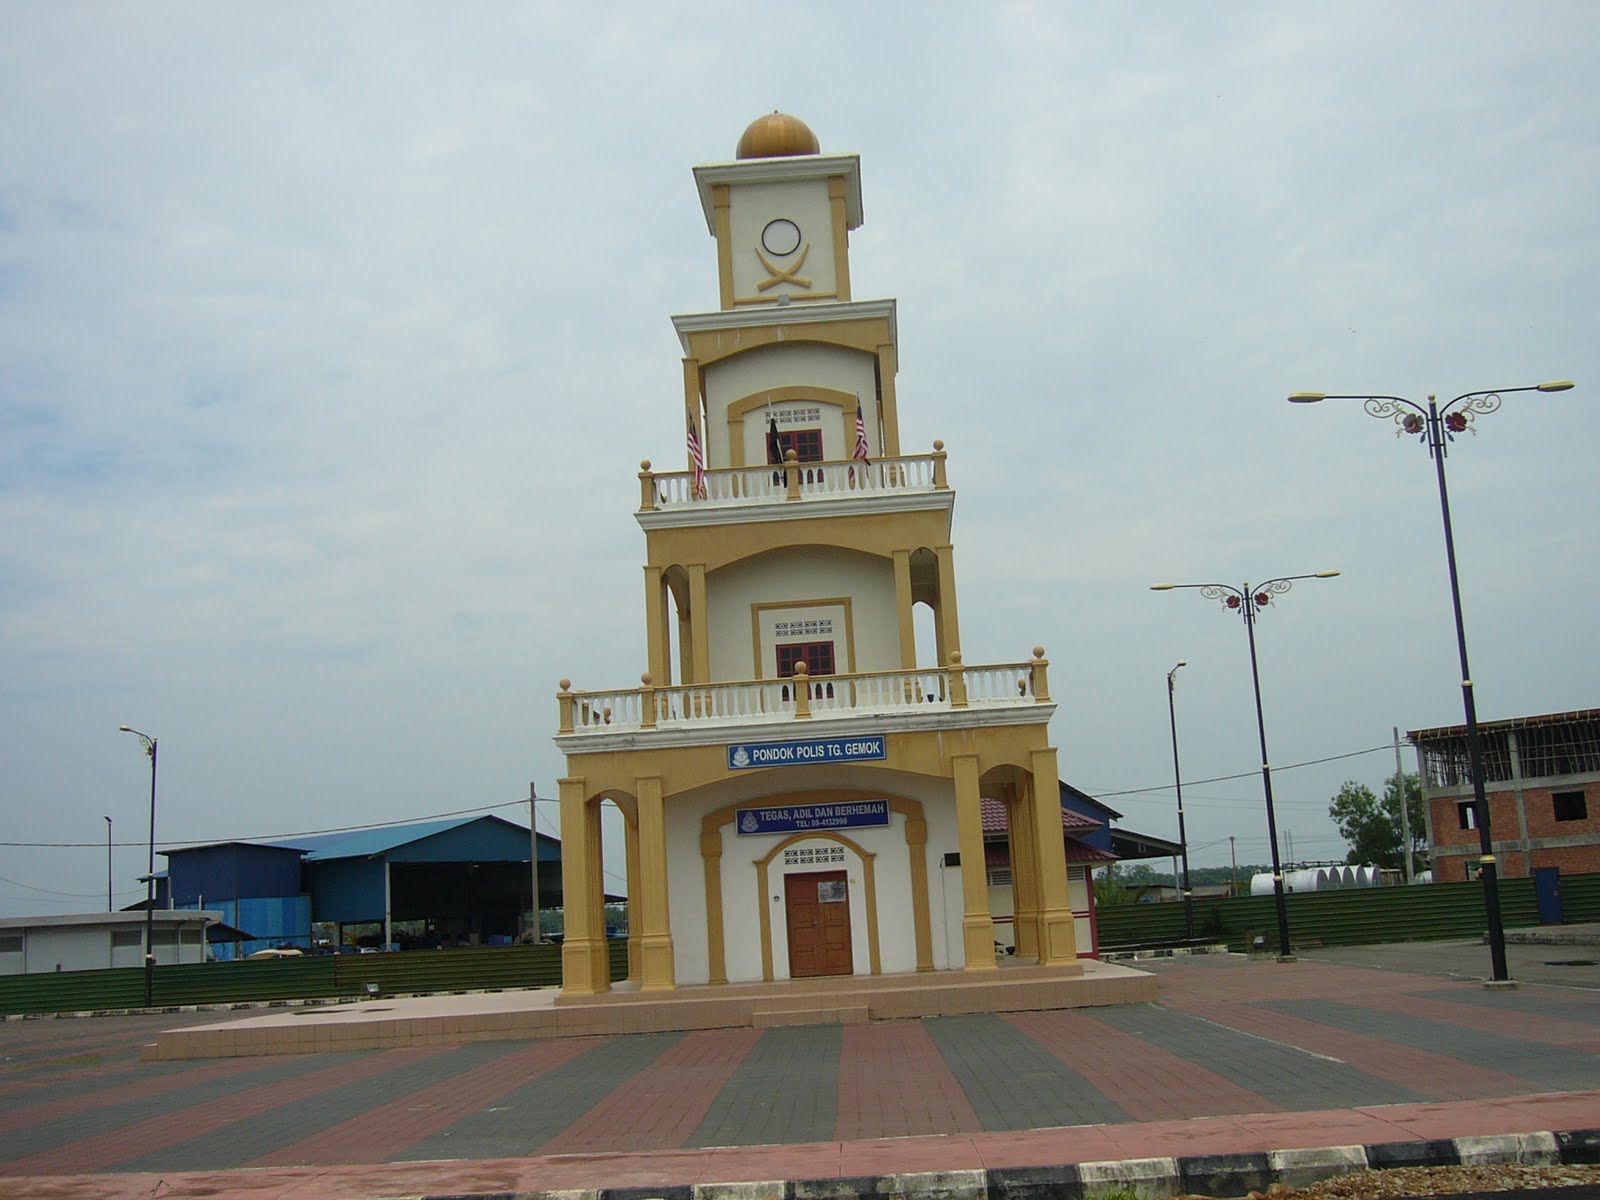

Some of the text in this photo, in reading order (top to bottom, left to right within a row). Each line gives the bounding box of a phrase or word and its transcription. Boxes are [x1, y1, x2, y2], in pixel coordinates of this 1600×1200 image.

[753, 742, 880, 761] PONDOK POLIS TG. GEMOK
[760, 804, 884, 821] TEGAS, ADIL DAN BERHEMAH
[796, 820, 811, 828] TEL:
